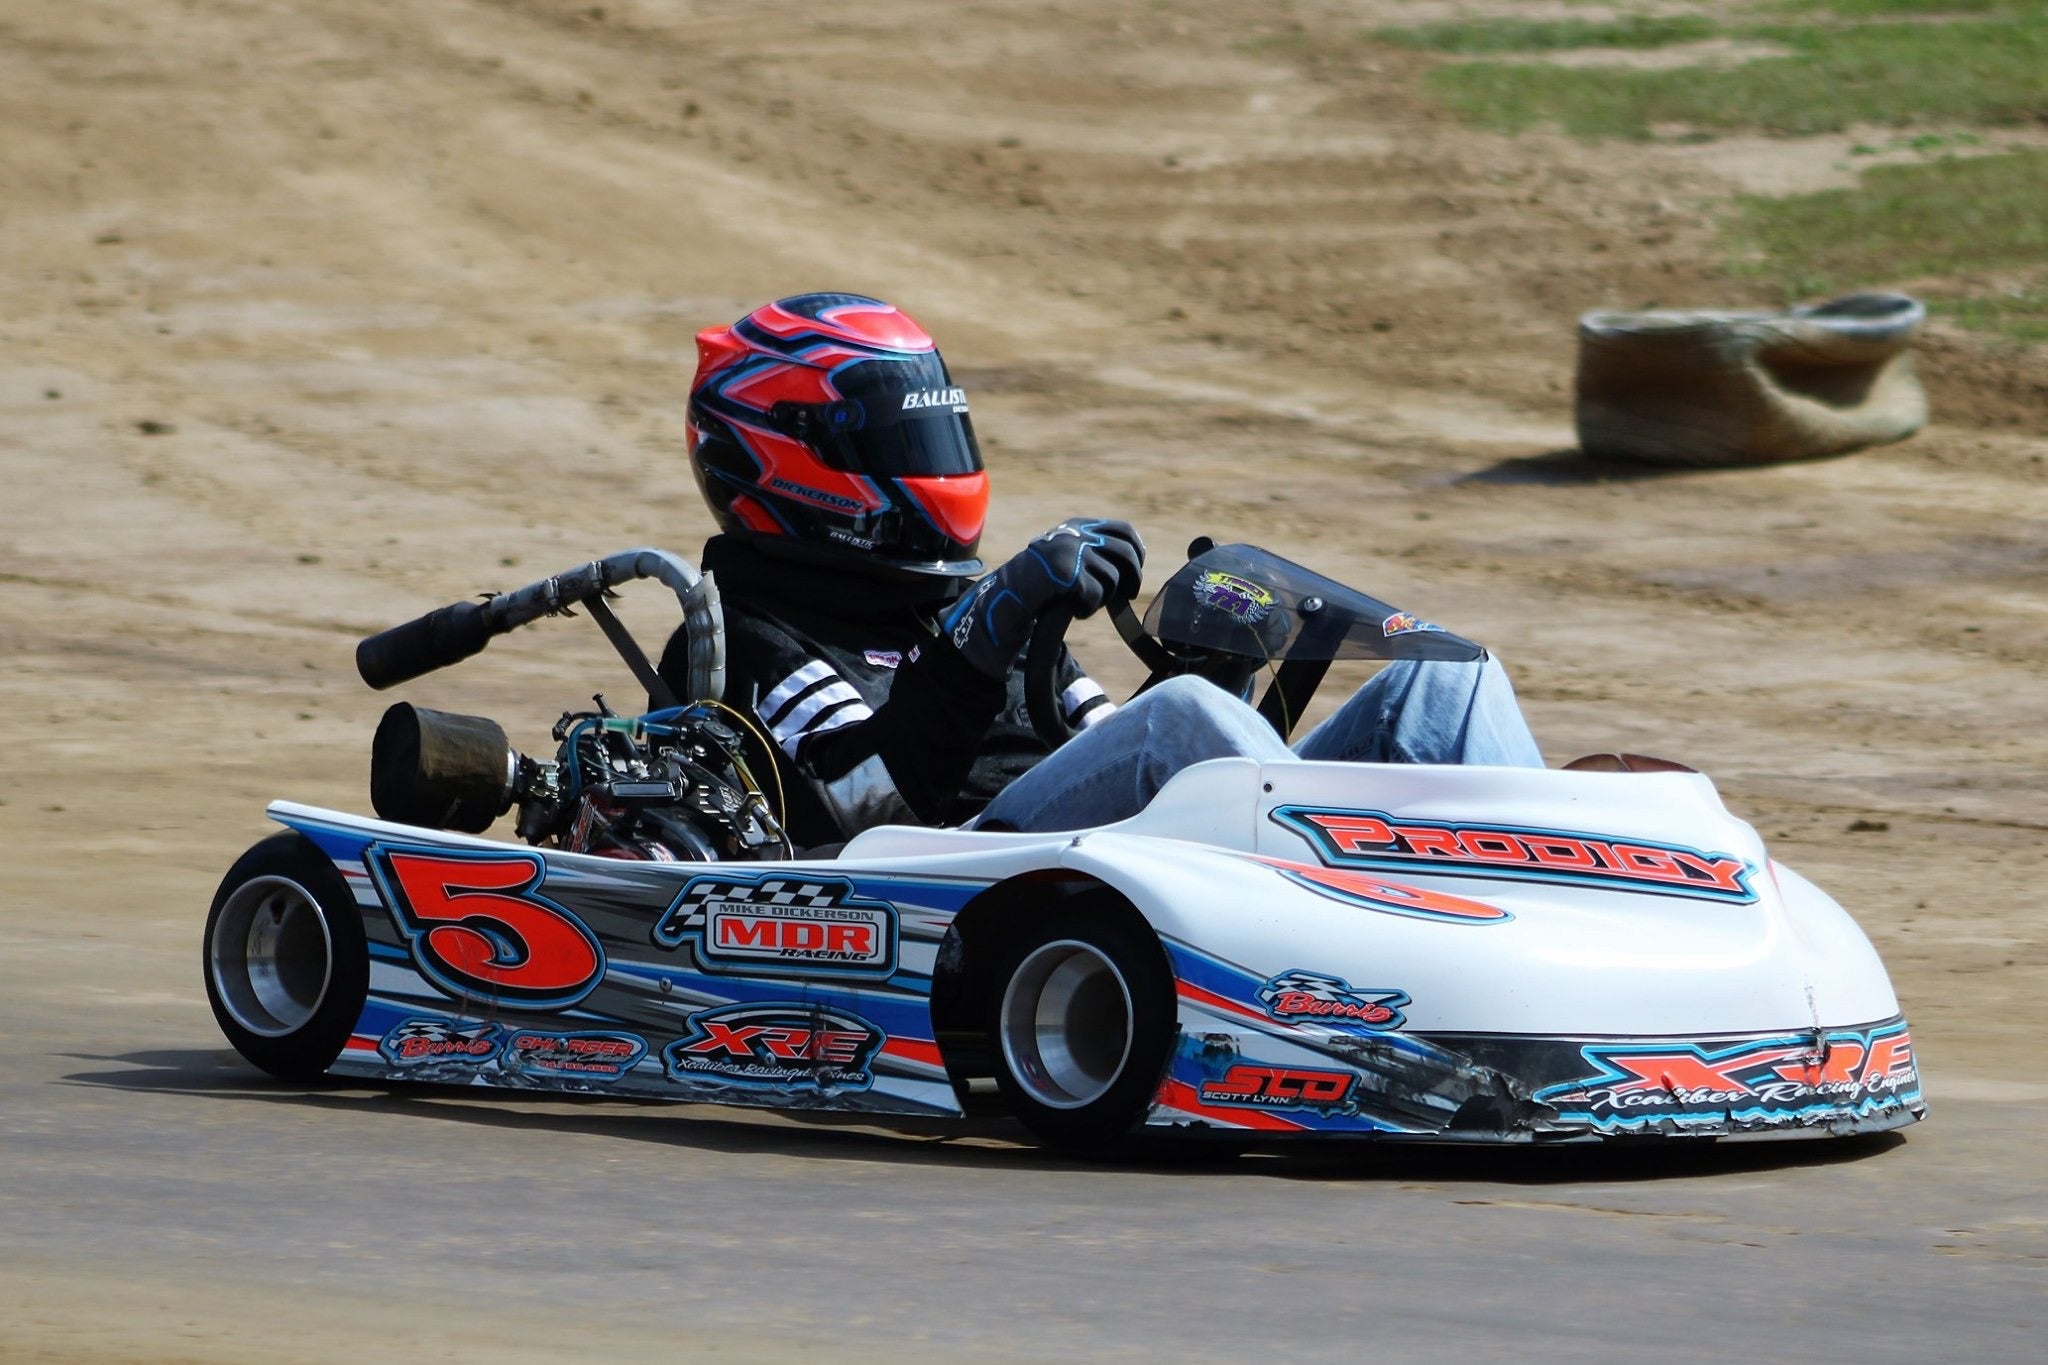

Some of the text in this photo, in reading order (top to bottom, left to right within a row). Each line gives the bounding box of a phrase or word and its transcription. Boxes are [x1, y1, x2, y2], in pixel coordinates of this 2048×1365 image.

[771, 478, 863, 511] DICKERSON
[1303, 814, 1746, 891] PRODIGY
[389, 852, 598, 989] 5
[719, 904, 873, 920] MIKE DICKERSON
[720, 918, 871, 952] MDR
[779, 948, 869, 961] RACING
[680, 1022, 870, 1063] XRE
[1606, 1033, 1911, 1092] XRE
[1202, 1091, 1290, 1104] SCOTT LYNN
[1866, 1069, 1917, 1093] Engines
